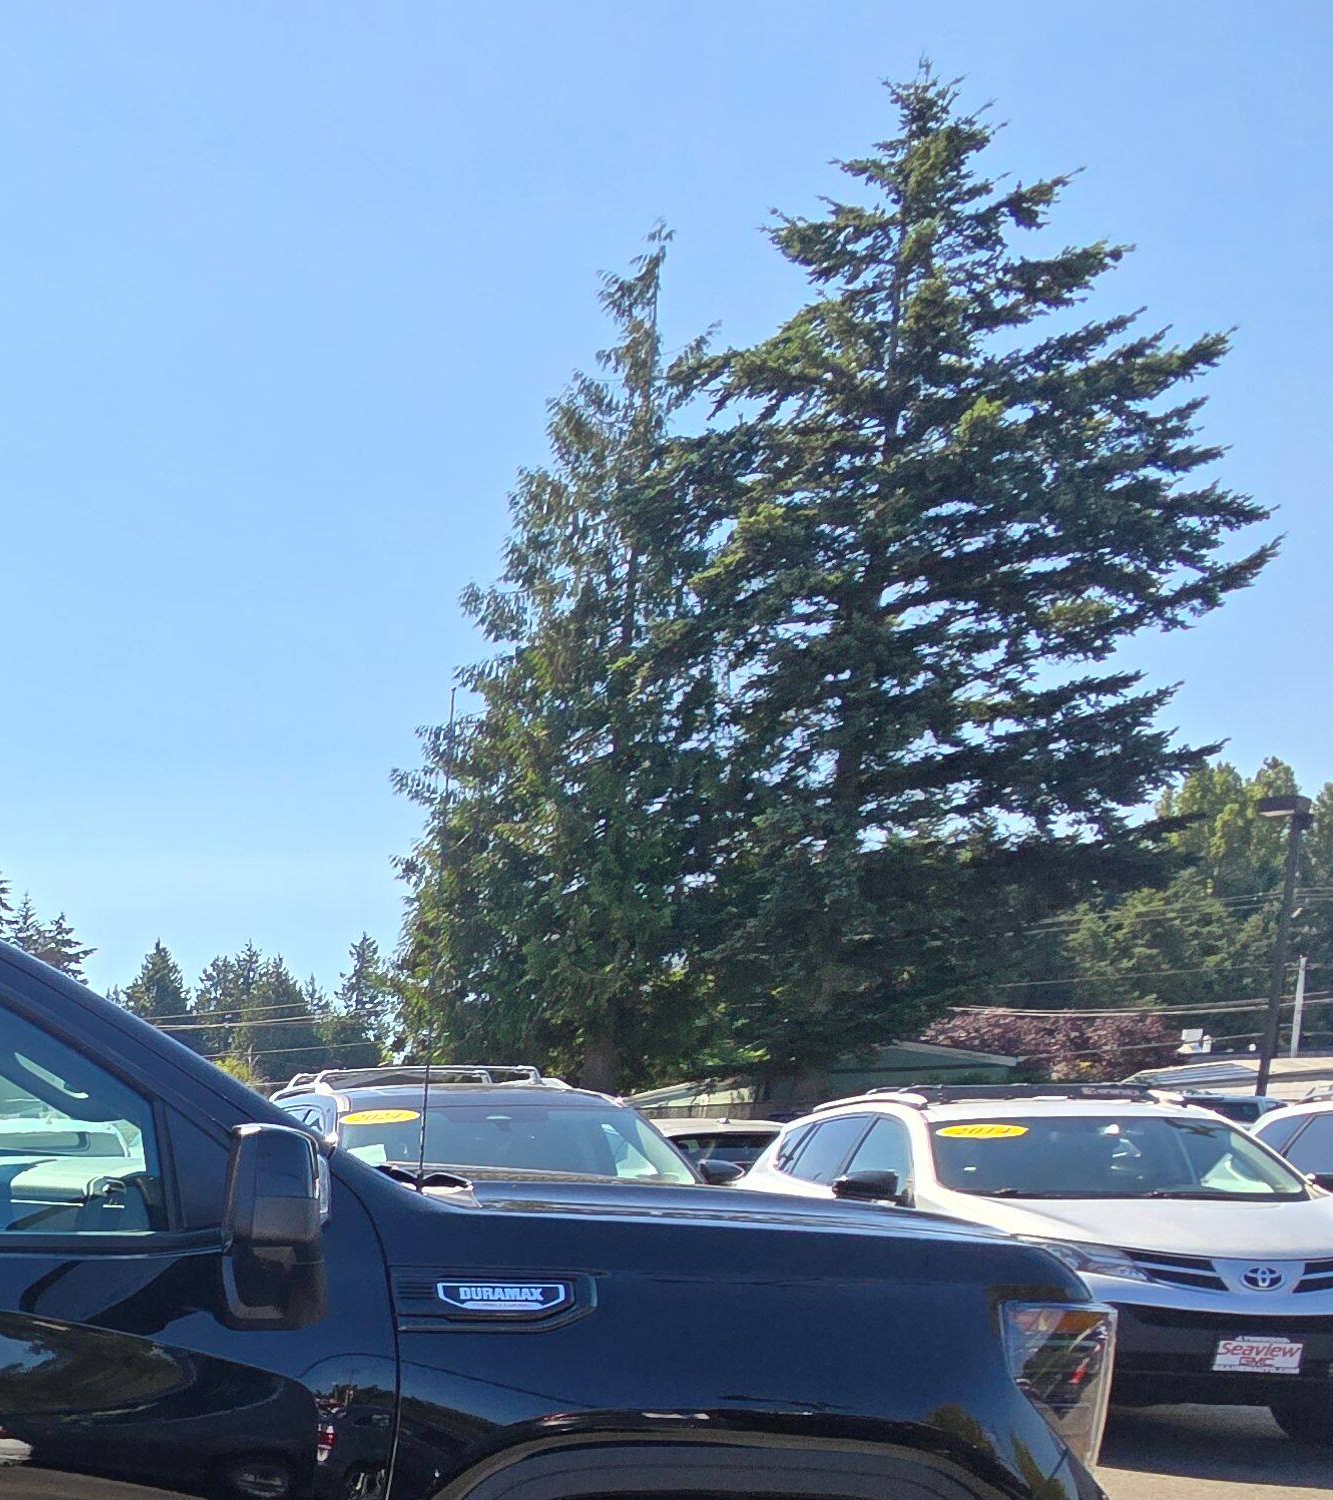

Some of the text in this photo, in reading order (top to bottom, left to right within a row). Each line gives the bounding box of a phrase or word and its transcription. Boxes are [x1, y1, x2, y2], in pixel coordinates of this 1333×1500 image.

[459, 1287, 544, 1301] DURAMAX
[1217, 1342, 1301, 1358] Seaview
[1239, 1356, 1275, 1367] GMC
